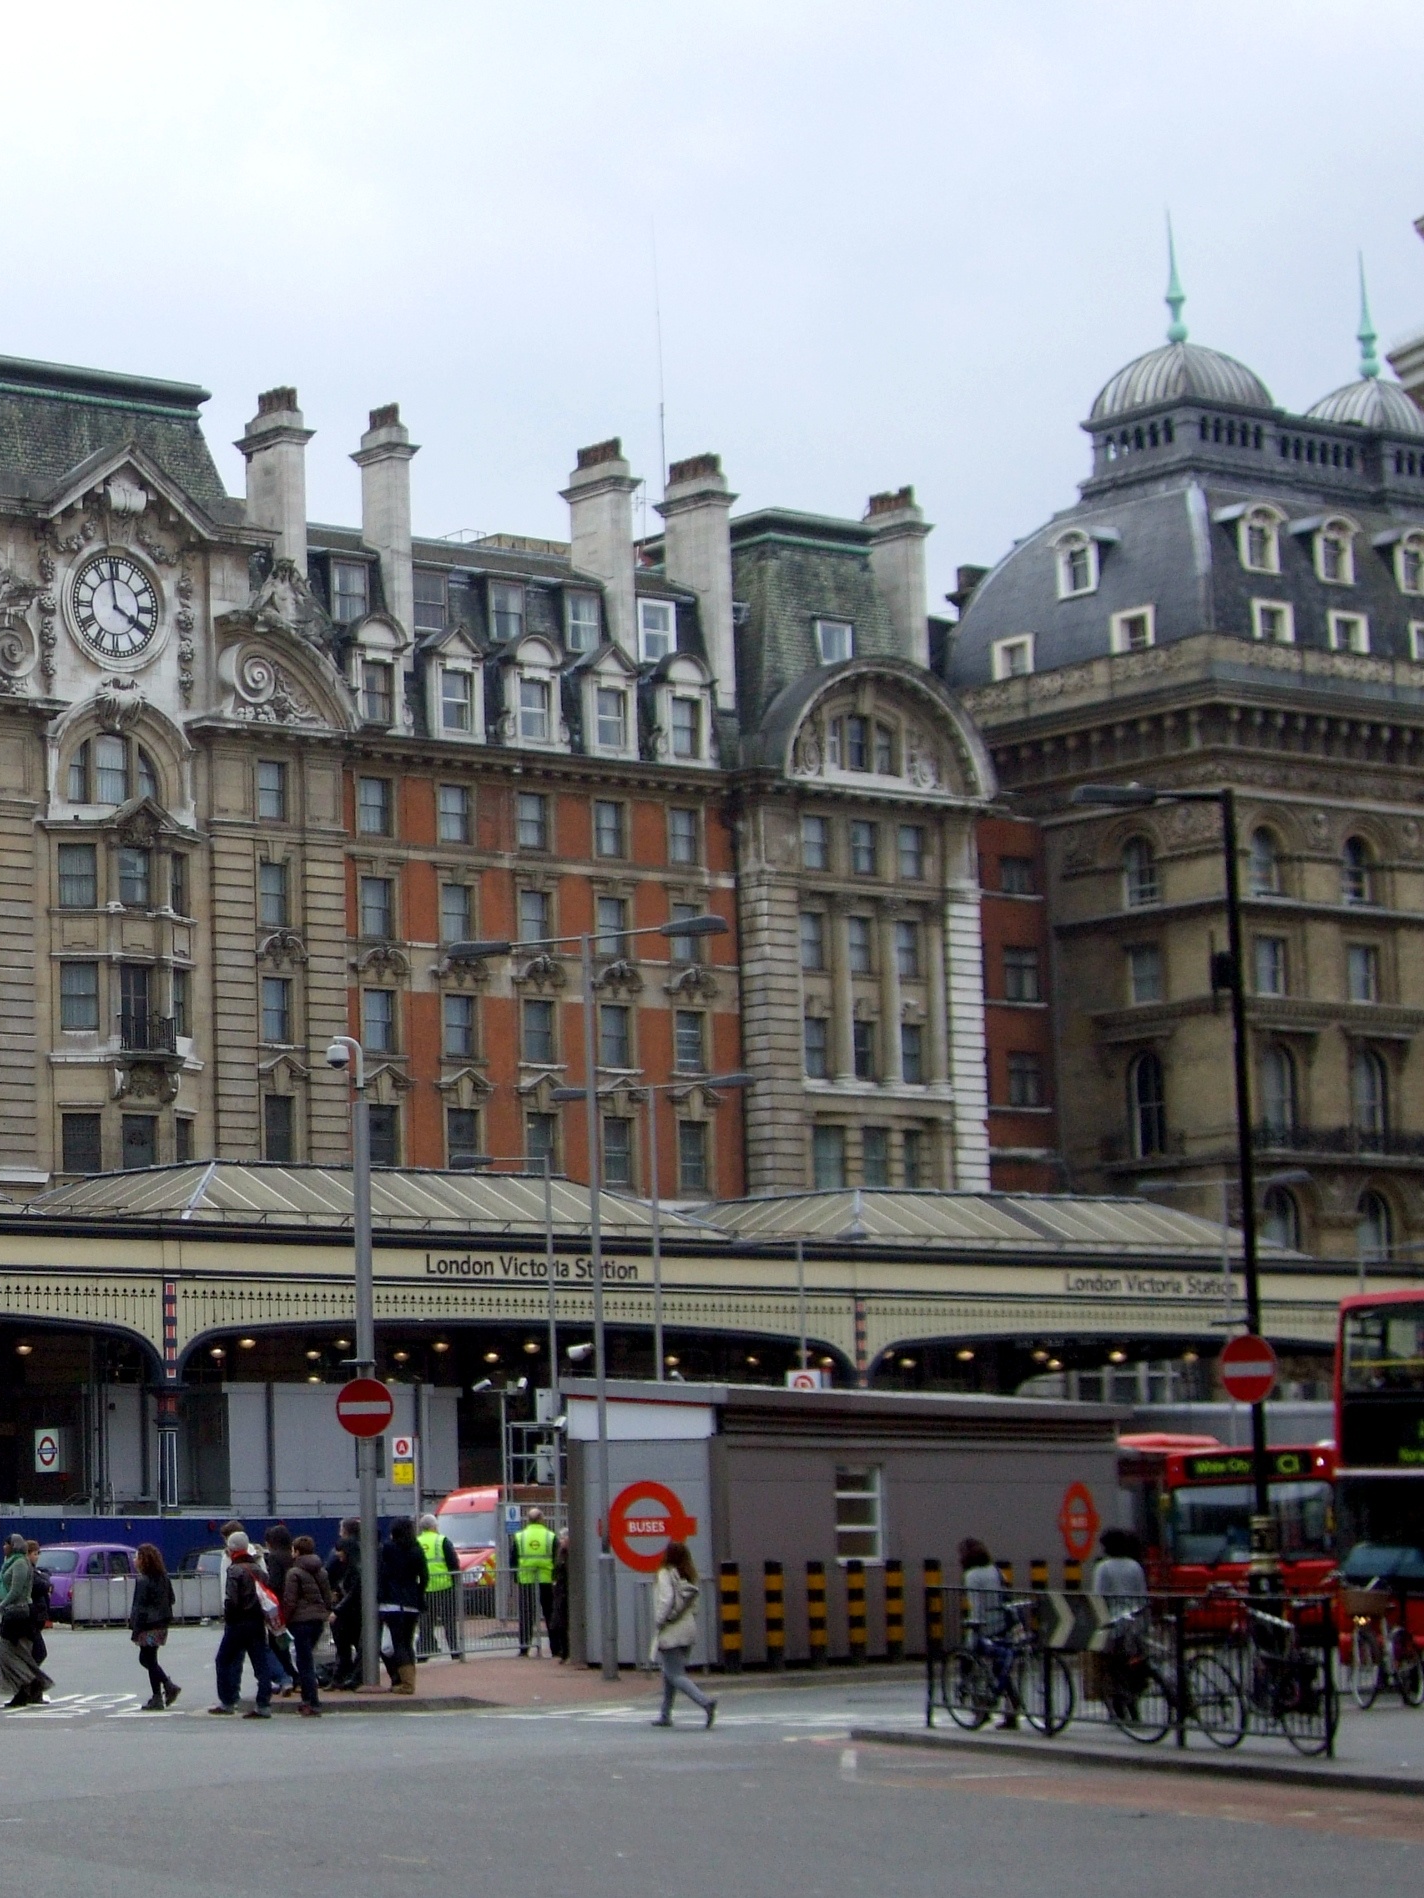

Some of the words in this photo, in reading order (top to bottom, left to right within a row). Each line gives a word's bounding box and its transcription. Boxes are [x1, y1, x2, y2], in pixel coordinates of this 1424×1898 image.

[426, 1254, 494, 1276] London
[575, 1258, 639, 1280] Sttion
[1065, 1273, 1122, 1292] London
[1126, 1274, 1183, 1294] Victoria
[629, 1521, 665, 1532] BUSES
